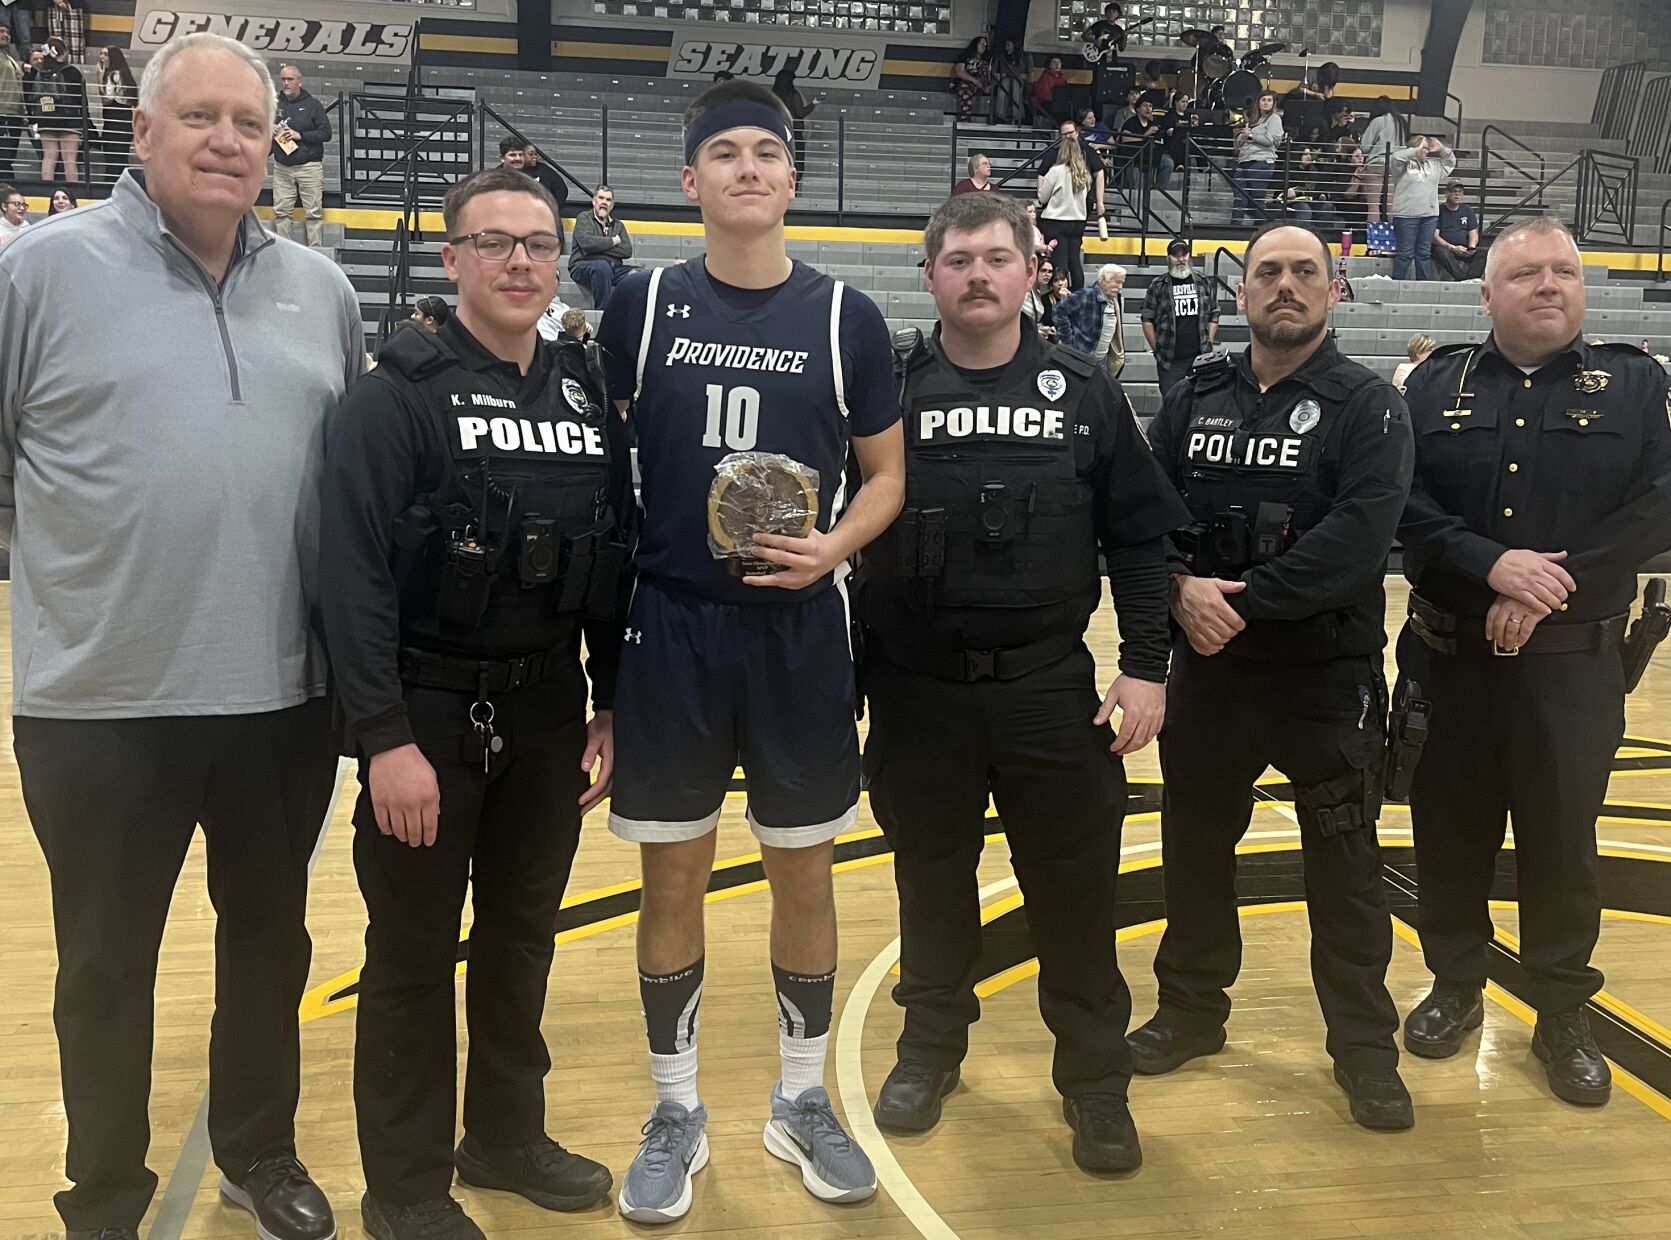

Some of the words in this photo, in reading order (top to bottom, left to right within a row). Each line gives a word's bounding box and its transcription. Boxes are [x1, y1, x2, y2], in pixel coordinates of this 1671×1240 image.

[138, 10, 413, 57] GENERALS
[673, 41, 878, 81] SEATING
[665, 337, 809, 374] PROVIDENCE
[450, 393, 465, 406] K.
[471, 393, 517, 409] Milburn
[702, 384, 761, 451] 10
[456, 416, 605, 456] POLICE
[920, 406, 1064, 440] POLICE
[1187, 433, 1302, 467] POLICE
